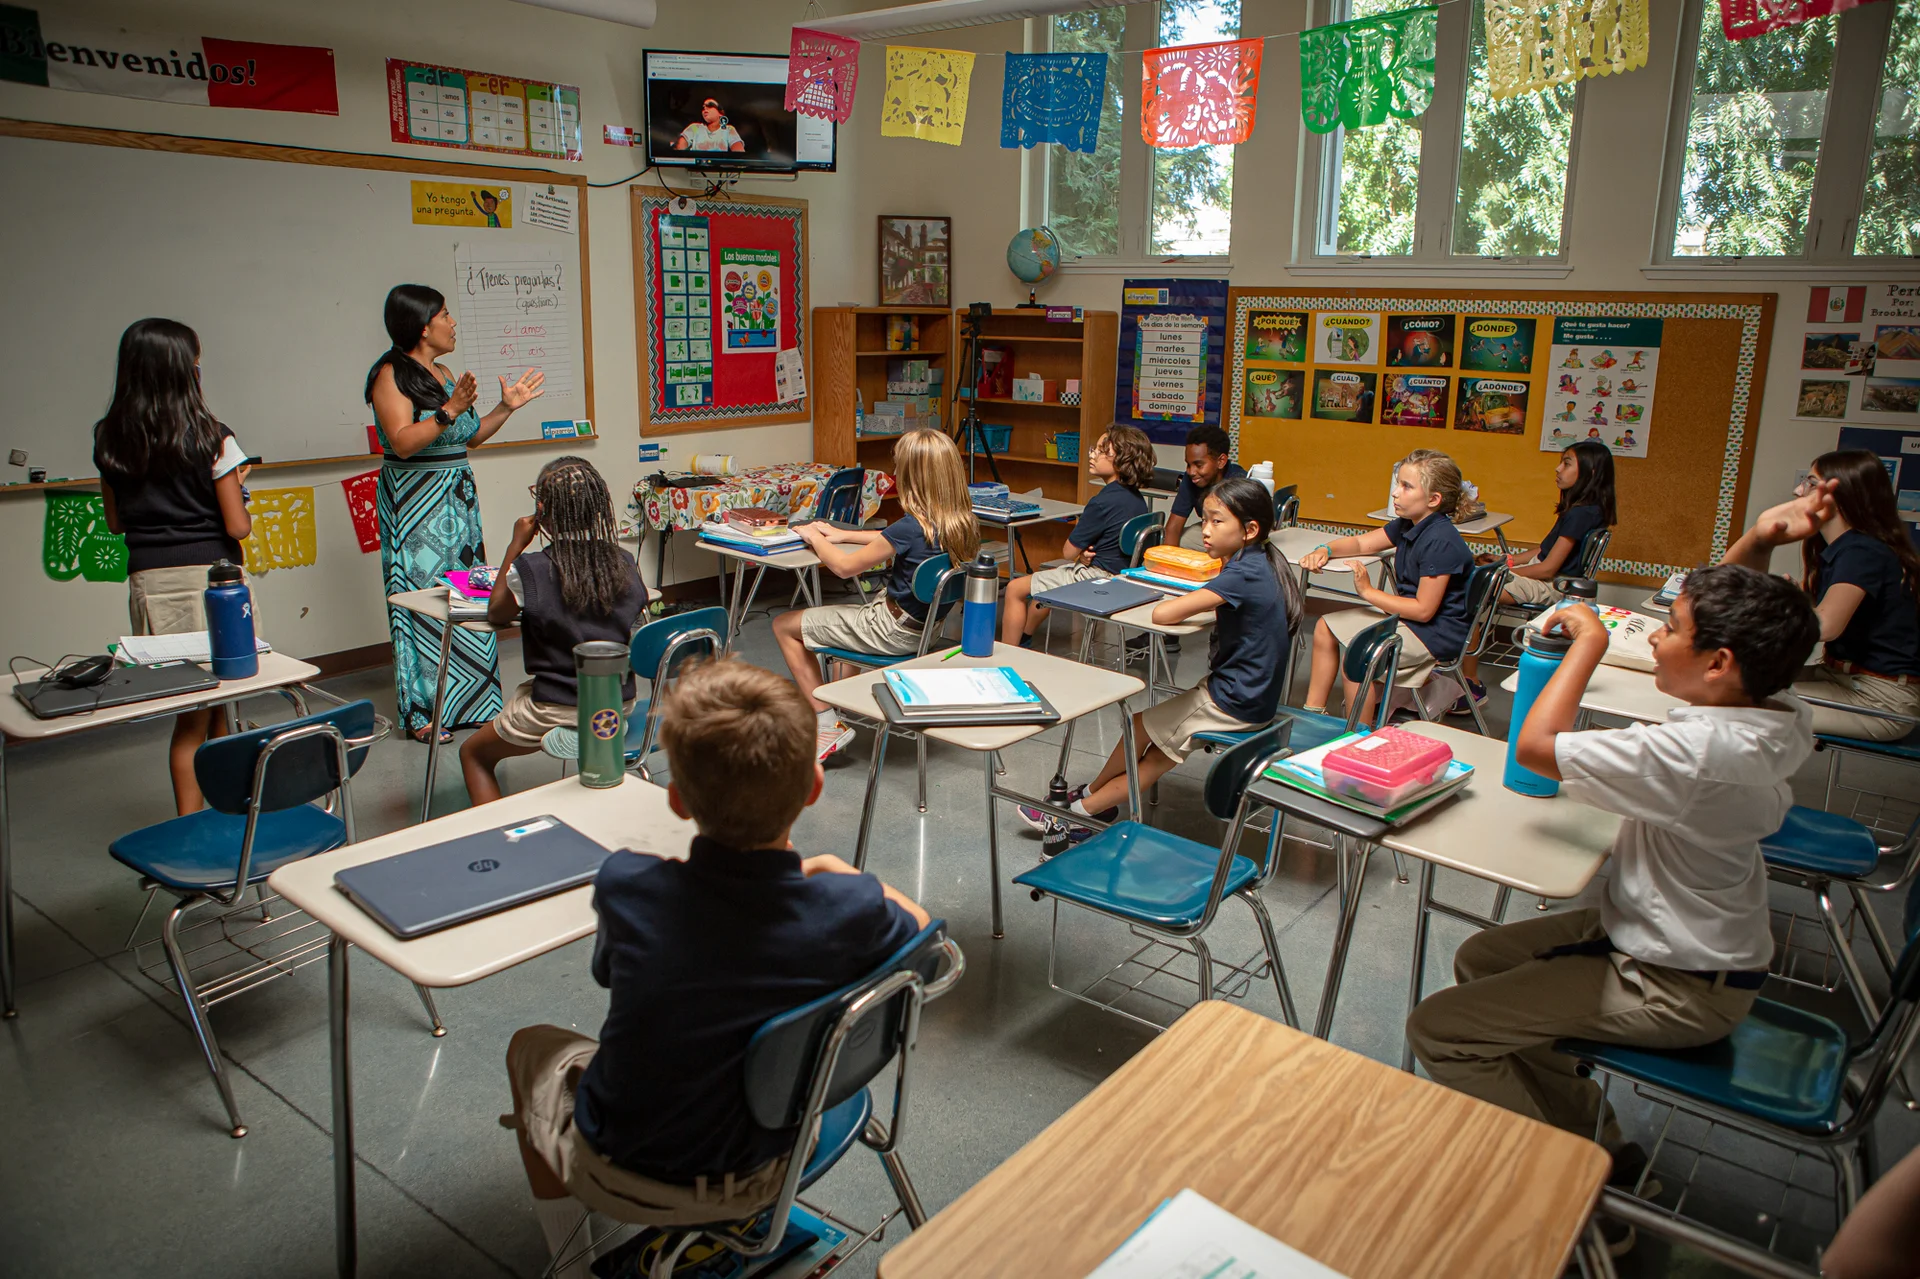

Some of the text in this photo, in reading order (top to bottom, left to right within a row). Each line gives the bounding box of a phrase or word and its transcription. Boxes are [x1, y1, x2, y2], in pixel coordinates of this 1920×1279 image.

[0, 23, 256, 86] Bienvenidos!
[415, 67, 451, 87] -ar
[479, 77, 510, 96] -er
[389, 78, 399, 122] PRESENT TENSE
[394, 68, 405, 133] REGULAR VERB ENDINGS
[442, 91, 460, 101] -amos
[502, 101, 519, 109] -emos
[426, 192, 467, 208] Yo tengo
[434, 207, 476, 220] pregunta.
[724, 251, 777, 263] Los buenos modales
[466, 263, 563, 295] ¿Tienes preguntas?
[515, 294, 559, 315] (questions)
[1891, 298, 1914, 307] Por:
[1256, 317, 1277, 327] ¿POR
[1325, 317, 1371, 327] ¿CUÁNDO?
[1403, 319, 1440, 331] ¿CÓMO?
[1470, 321, 1516, 334] ¿DÓNDE?
[1561, 321, 1577, 329] ¿Qué
[520, 324, 547, 336] amos
[1159, 332, 1183, 341] lunes
[499, 344, 515, 359] as
[1155, 344, 1185, 353] martes
[1148, 356, 1191, 365] miércoles
[1154, 367, 1183, 376] jueves
[1152, 379, 1184, 388] viernes
[1250, 373, 1277, 383] ¿QUÉ?
[1332, 374, 1360, 384] ¿CUÁL?
[1409, 377, 1446, 388] ¿CUÁNTO?
[1477, 382, 1525, 393] ¿ADÓNDE?
[1151, 391, 1185, 400] sábado
[1148, 402, 1187, 413] domingo
[545, 425, 551, 436] el
